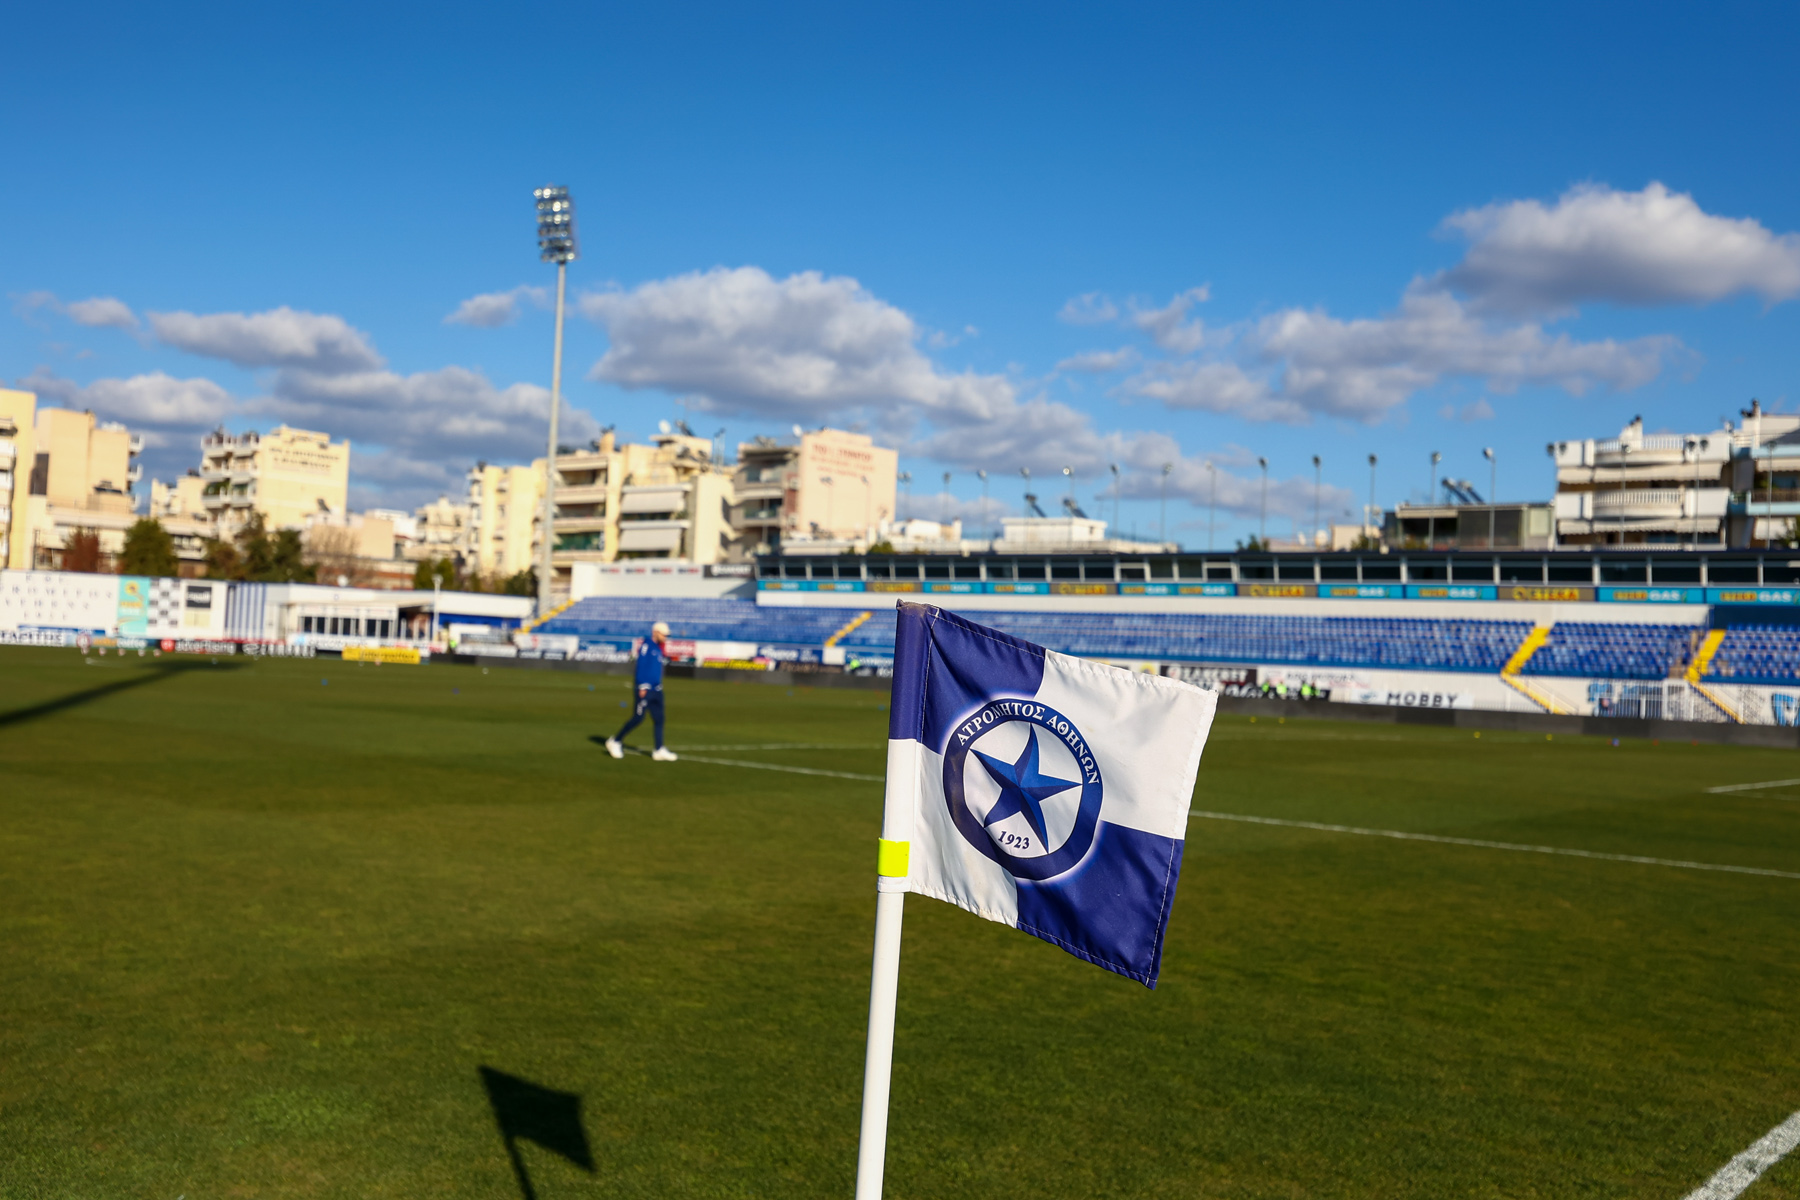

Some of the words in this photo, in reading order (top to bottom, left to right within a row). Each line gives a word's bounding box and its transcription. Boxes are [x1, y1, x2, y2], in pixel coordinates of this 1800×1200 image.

[1759, 591, 1792, 602] GAS
[1386, 691, 1458, 708] MOBBY
[1046, 715, 1100, 784] ΑΘΗΝΩΝ
[998, 830, 1030, 849] 1923
